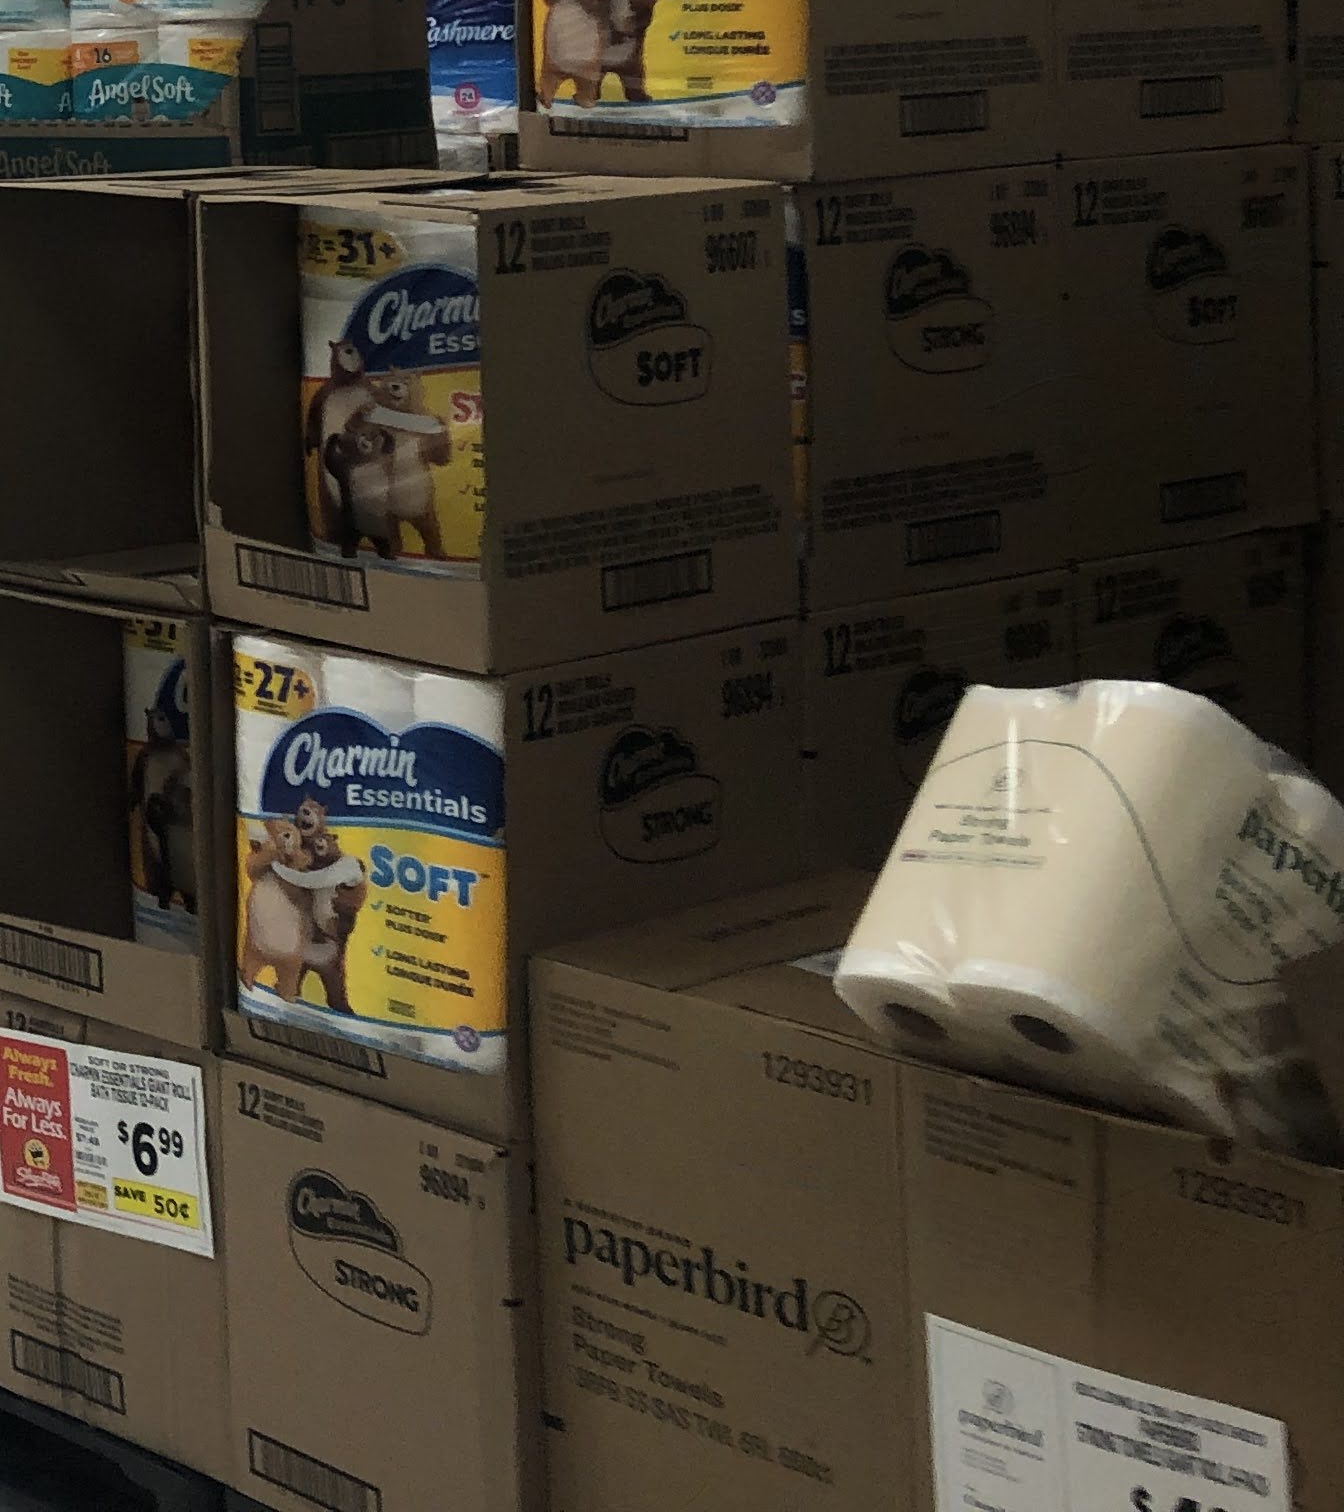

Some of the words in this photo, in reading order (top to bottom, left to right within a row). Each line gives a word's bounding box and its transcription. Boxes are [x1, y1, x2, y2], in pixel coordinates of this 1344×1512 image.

[637, 348, 702, 386] SOFT
[283, 731, 417, 788] Charmin
[346, 783, 487, 824] Essentials
[369, 844, 478, 908] SOFT
[2, 1046, 57, 1073] Always
[8, 1065, 54, 1088] Fresh.
[88, 1056, 110, 1069] SOFT
[762, 1051, 873, 1105] 1293931
[4, 1087, 62, 1119] Always
[238, 1082, 260, 1120] 12
[2, 1106, 28, 1128] For
[31, 1118, 67, 1140] Less.
[115, 1185, 147, 1203] SAVE
[154, 1193, 190, 1220] 50¢
[335, 1260, 419, 1312] STRONG
[564, 1216, 809, 1332] paperbird
